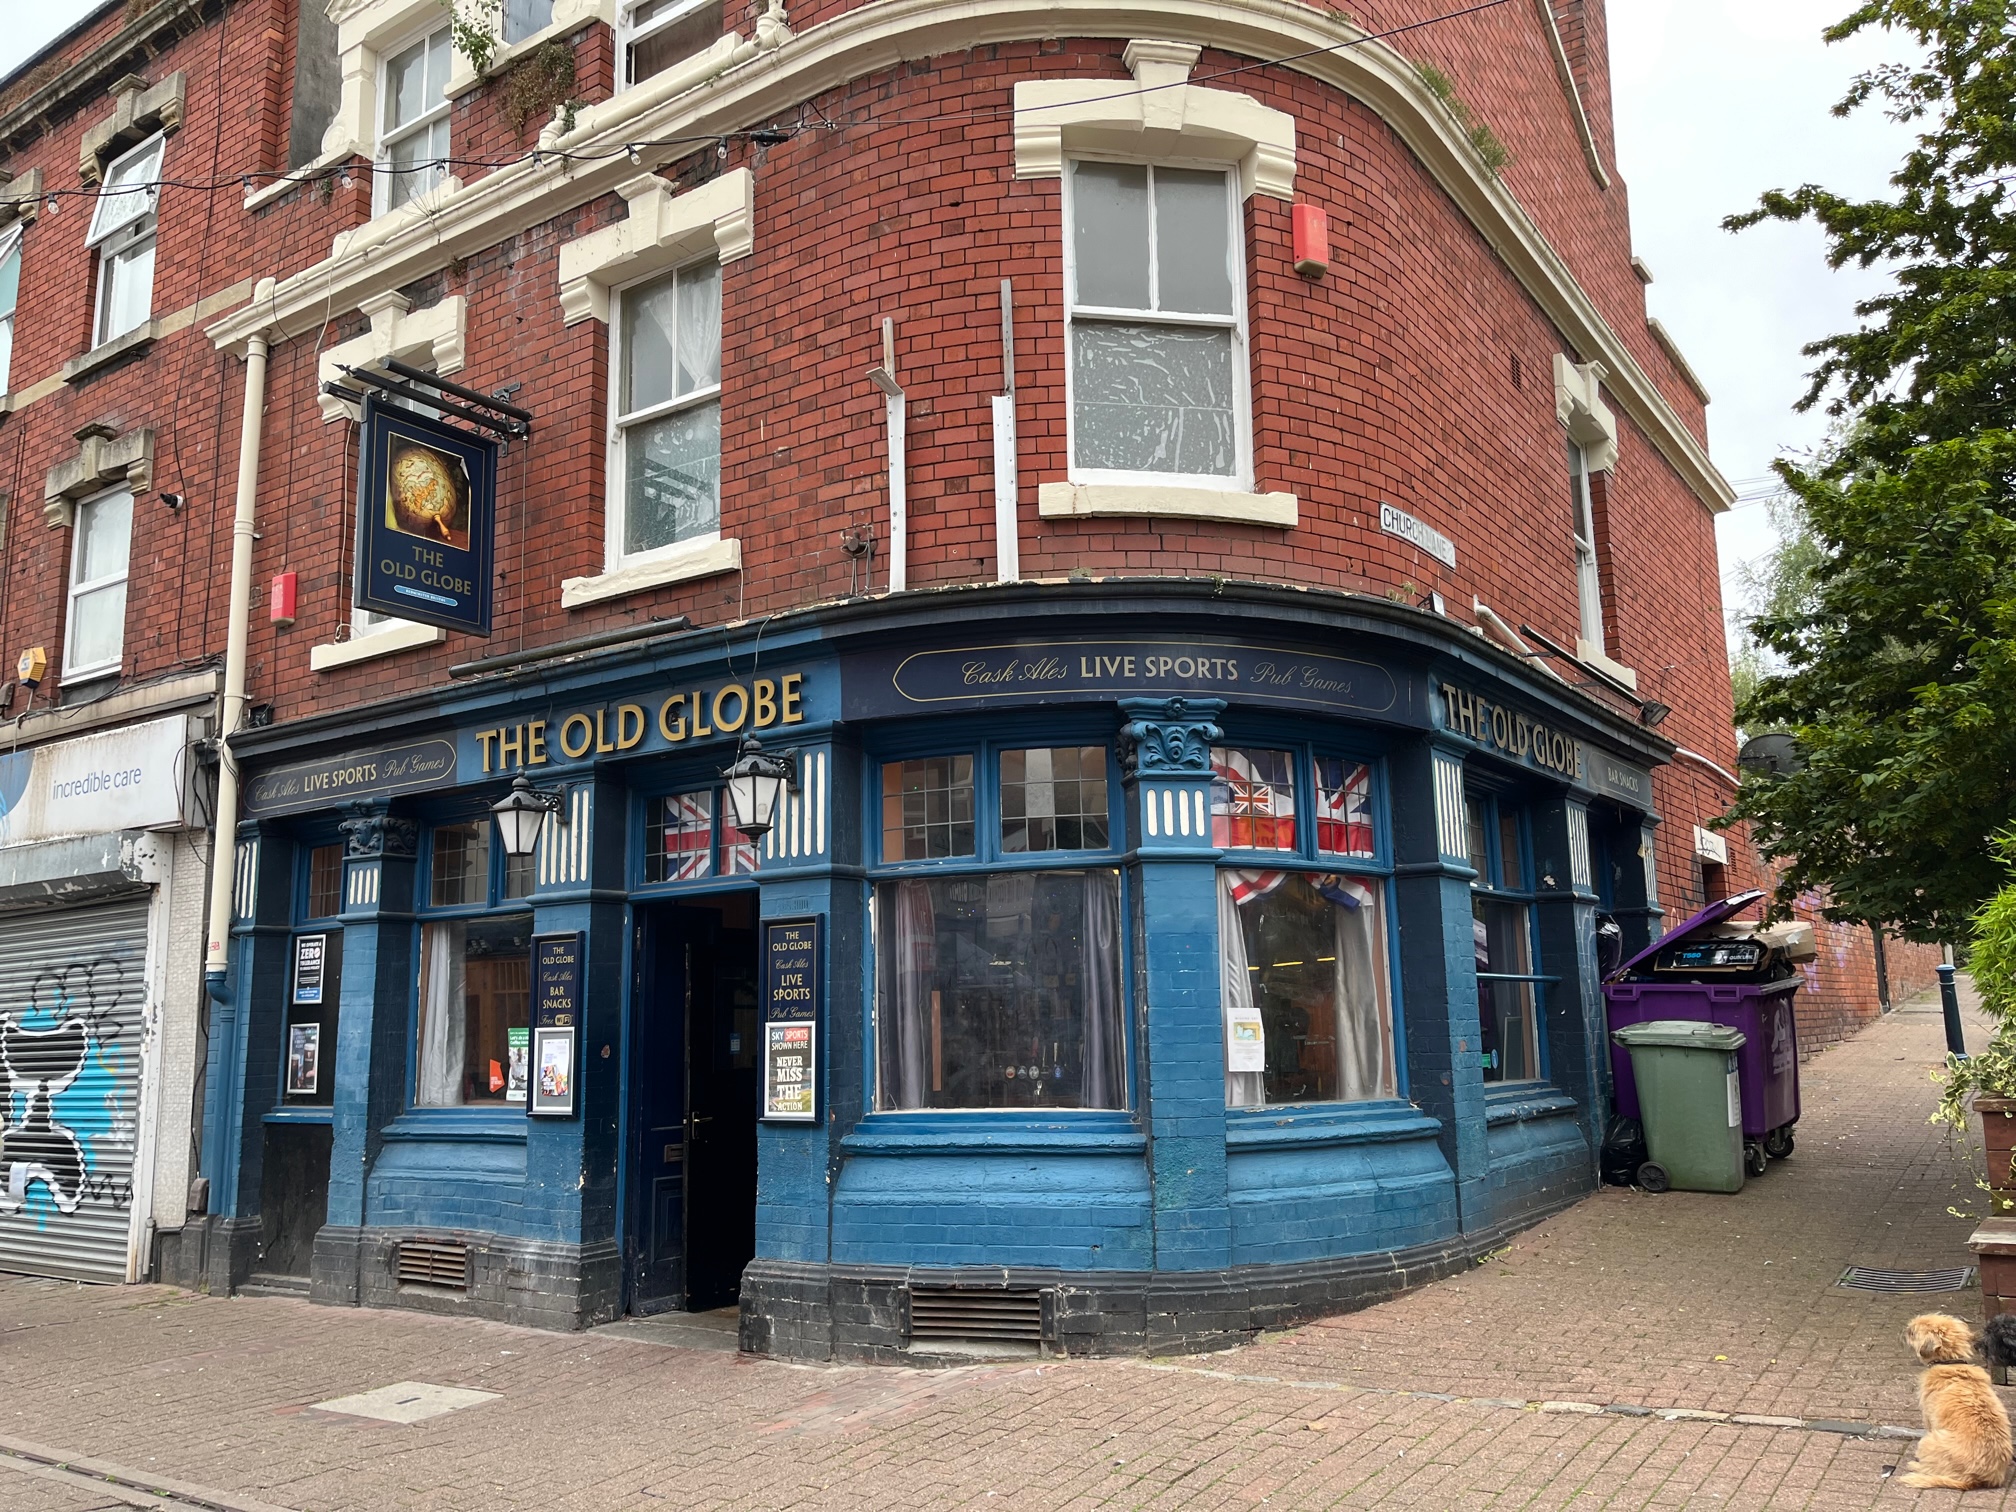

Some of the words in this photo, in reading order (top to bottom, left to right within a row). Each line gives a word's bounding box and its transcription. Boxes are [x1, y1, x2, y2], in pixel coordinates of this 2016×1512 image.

[1384, 508, 1423, 544] CHURCH
[412, 546, 444, 568] THE
[380, 559, 416, 580] OLD
[421, 570, 471, 596] GLOBE
[962, 658, 1019, 684] Cask
[1019, 657, 1068, 681] Ales
[1080, 656, 1136, 678] LIVE
[1145, 656, 1238, 681] SPORTS
[1250, 662, 1297, 685] Pub
[1300, 666, 1351, 694] Games
[476, 719, 548, 773] THE
[560, 704, 645, 758] OLD
[659, 672, 803, 742] GLOBE
[1443, 682, 1486, 741] THE
[1492, 705, 1528, 756] OLD
[1532, 724, 1582, 780] GLOBE
[53, 771, 111, 800] incredible
[114, 768, 142, 788] care
[255, 784, 277, 801] Cask
[278, 779, 300, 797] Ales
[304, 775, 329, 793] LIVE
[332, 764, 377, 787] SPORTS
[382, 757, 408, 779] Pub
[410, 754, 445, 774] Games
[1608, 767, 1618, 783] BAR
[1619, 772, 1638, 792] SNACKS
[785, 931, 799, 940] THE
[772, 943, 787, 951] OLD
[789, 941, 812, 950] GLOBE
[300, 947, 320, 960] ZERO
[556, 956, 574, 964] GLOBE
[781, 974, 802, 986] LIVE
[550, 986, 564, 996] BAR
[774, 988, 810, 1001] SPORTS
[543, 999, 571, 1009] SNACKS
[770, 1007, 789, 1019] Pub
[789, 1006, 814, 1018] Games
[772, 1031, 784, 1040] SKY
[786, 1030, 808, 1040] SPORTS
[771, 1041, 792, 1050] SHOWN
[793, 1041, 808, 1049] HERE
[776, 1056, 803, 1067] NEVER
[777, 1067, 803, 1082] MISS
[777, 1084, 802, 1100] THE
[778, 1101, 802, 1111] ACTION
